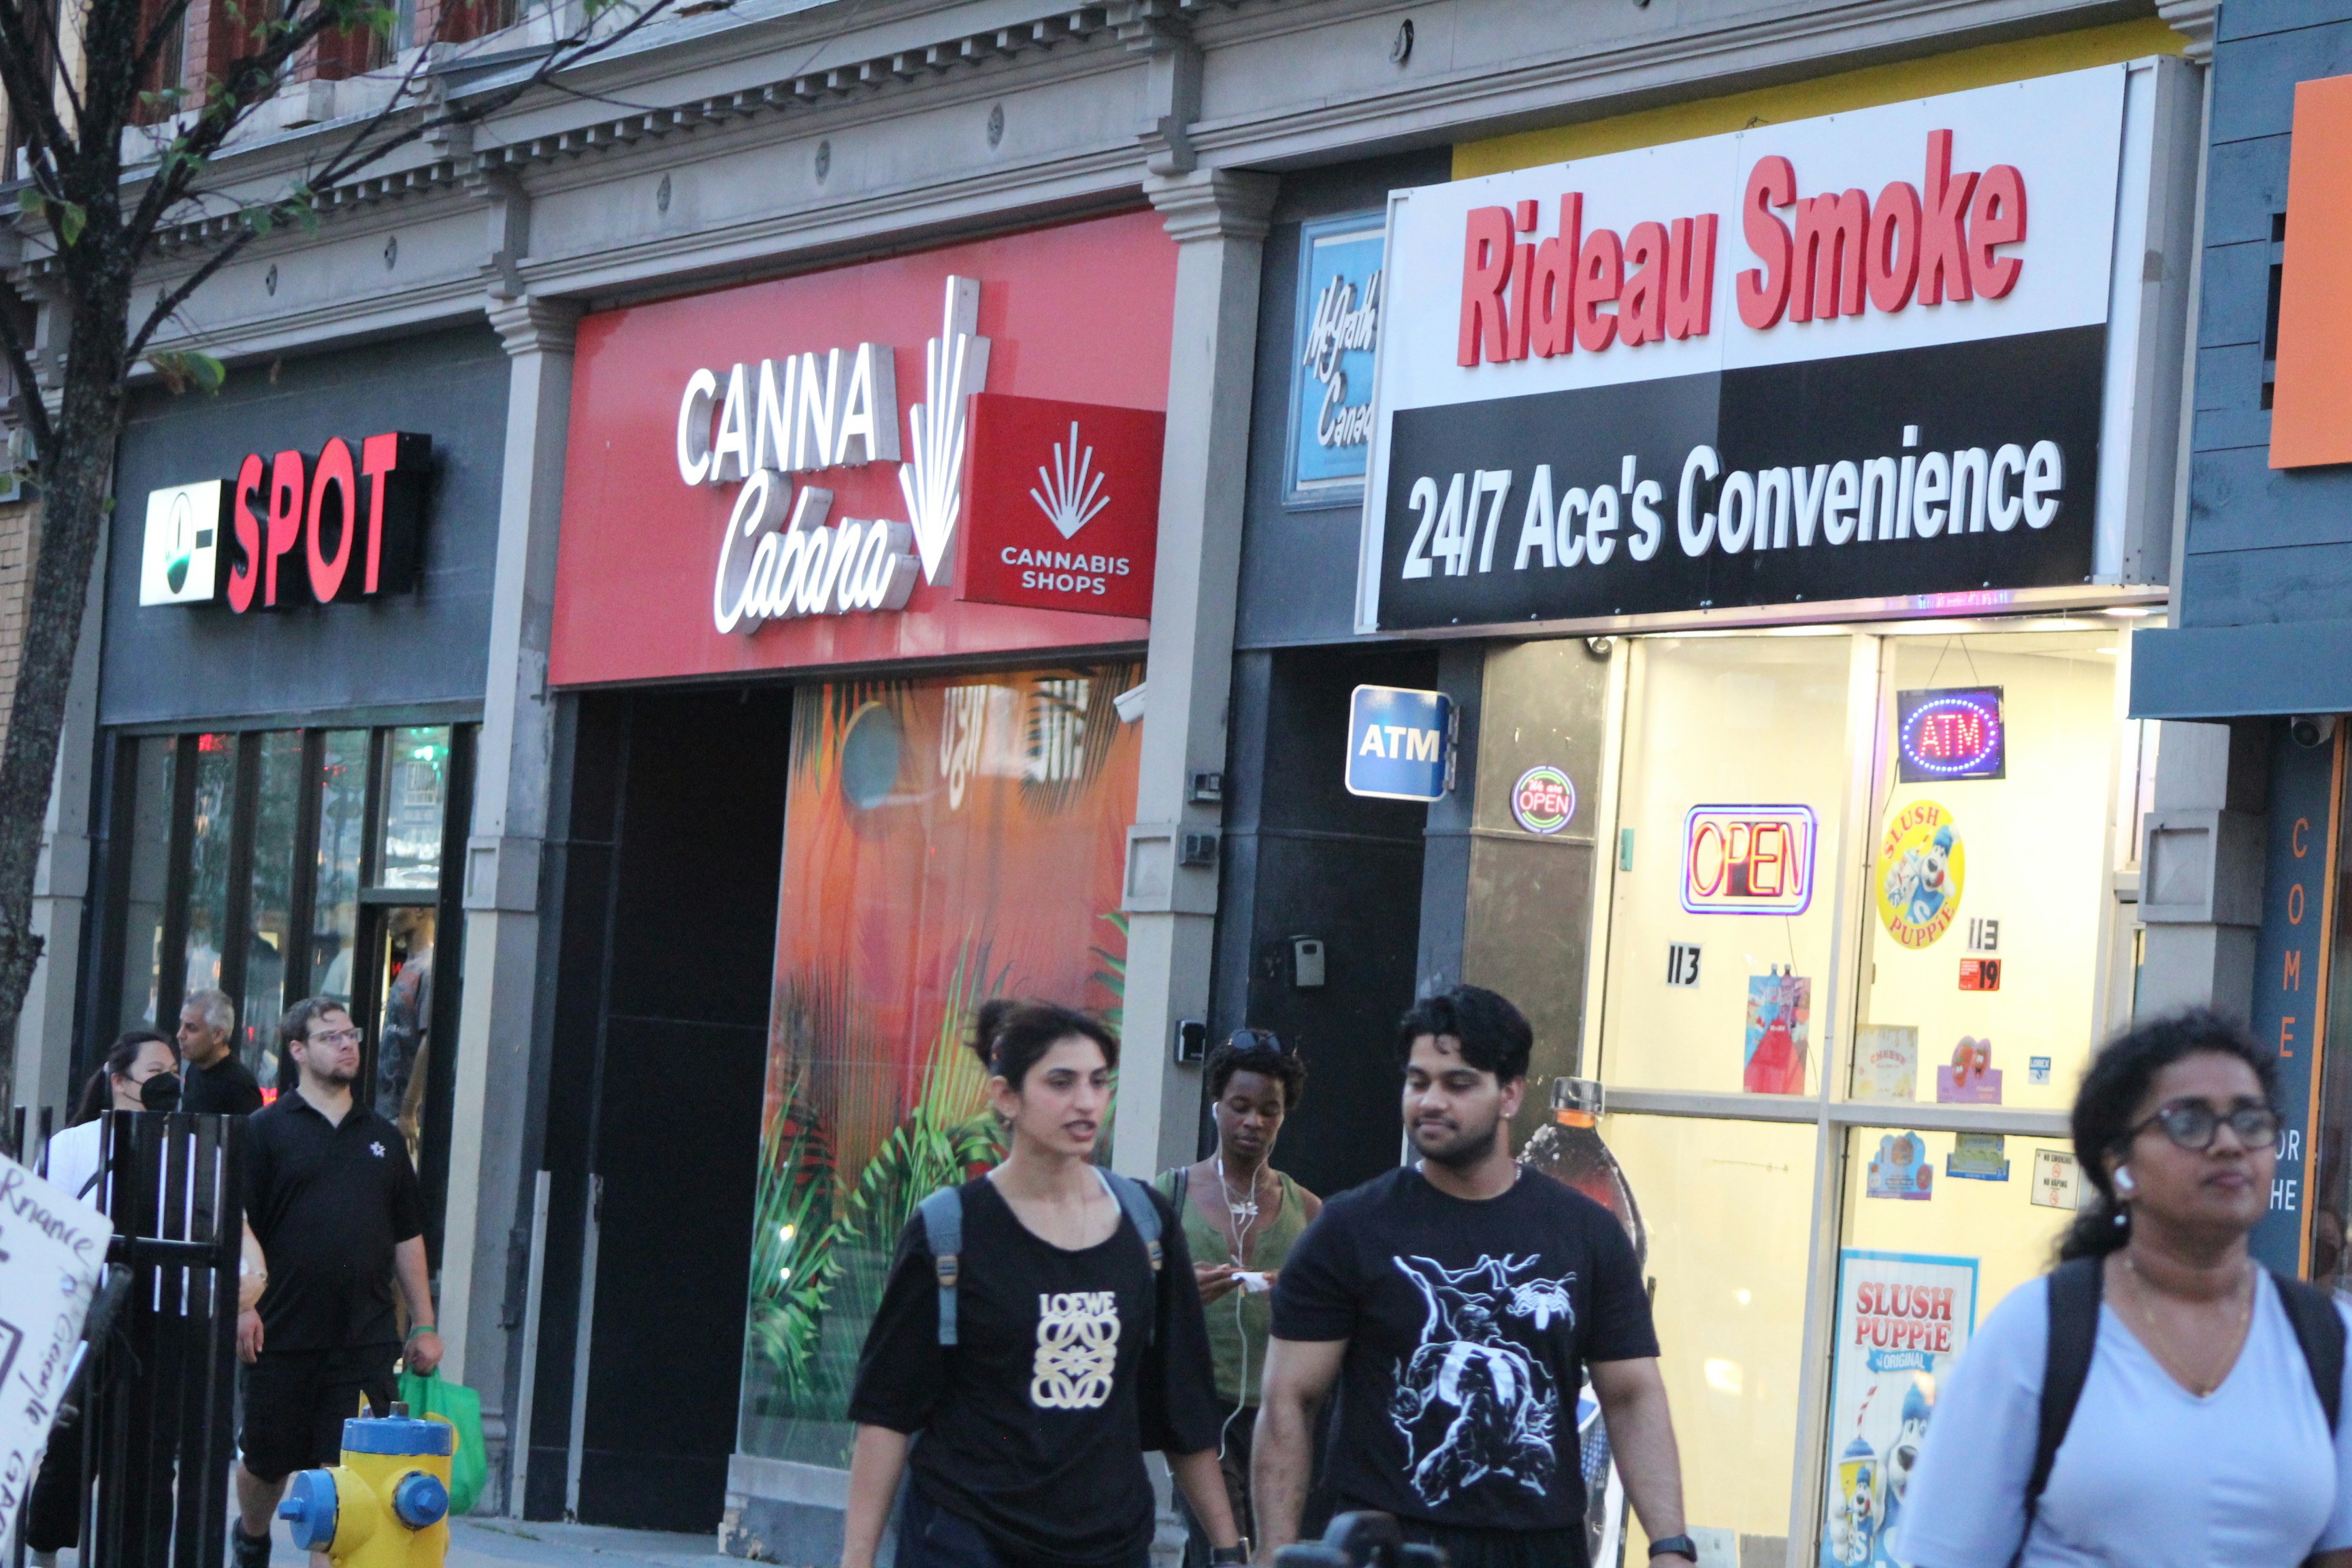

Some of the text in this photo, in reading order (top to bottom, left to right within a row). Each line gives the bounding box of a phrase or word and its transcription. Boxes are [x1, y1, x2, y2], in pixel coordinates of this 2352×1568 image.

[1457, 128, 2027, 368] Rideau Smoke
[676, 342, 901, 486] CANNA
[1402, 425, 2062, 578] 24/7 Ace's Convenience
[227, 431, 399, 613] SPOT
[715, 468, 919, 634] Cabana
[1000, 546, 1130, 576] CANNABIS
[1022, 570, 1107, 595] SHOPS
[1359, 724, 1441, 762] ATM
[1920, 713, 1980, 757] ATM
[1520, 791, 1569, 814] OPEN
[1883, 806, 1940, 860] SLUSH
[1688, 821, 1808, 897] OPEN
[1968, 917, 1999, 950] 113
[2278, 818, 2309, 1058] COME
[1667, 945, 1701, 985] 113
[1979, 960, 1998, 989] 19
[2270, 1179, 2298, 1210] HE
[1039, 1292, 1117, 1317] LOEWE
[1856, 1281, 1955, 1321] SLUSH
[1884, 1352, 1925, 1369] ORIGINAL
